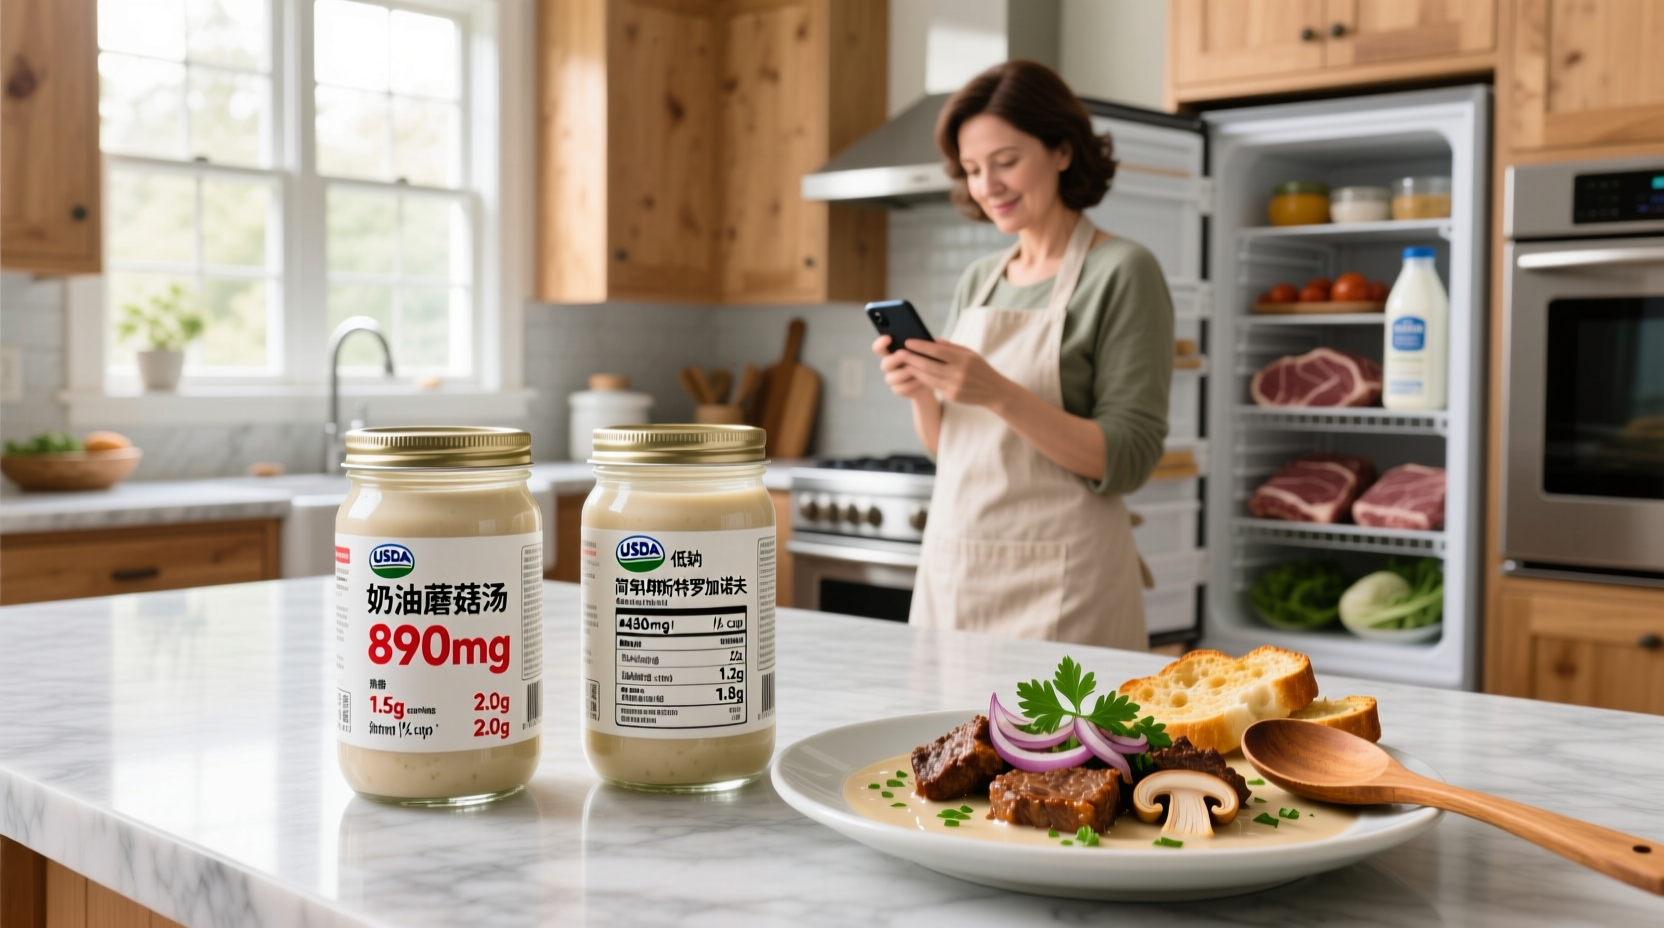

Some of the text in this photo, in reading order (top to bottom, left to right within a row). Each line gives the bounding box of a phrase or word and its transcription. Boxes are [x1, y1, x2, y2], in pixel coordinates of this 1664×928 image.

[373, 549, 412, 563] USDA
[620, 542, 660, 557] USDA
[366, 582, 508, 616] 奶油蘑菇汤
[368, 623, 510, 674] 890mg
[719, 667, 744, 683] 1.2g
[473, 692, 510, 714] 2.0g
[715, 686, 744, 703] 1.8g
[370, 695, 405, 720] 1.5g
[473, 717, 510, 740] 2.0g
